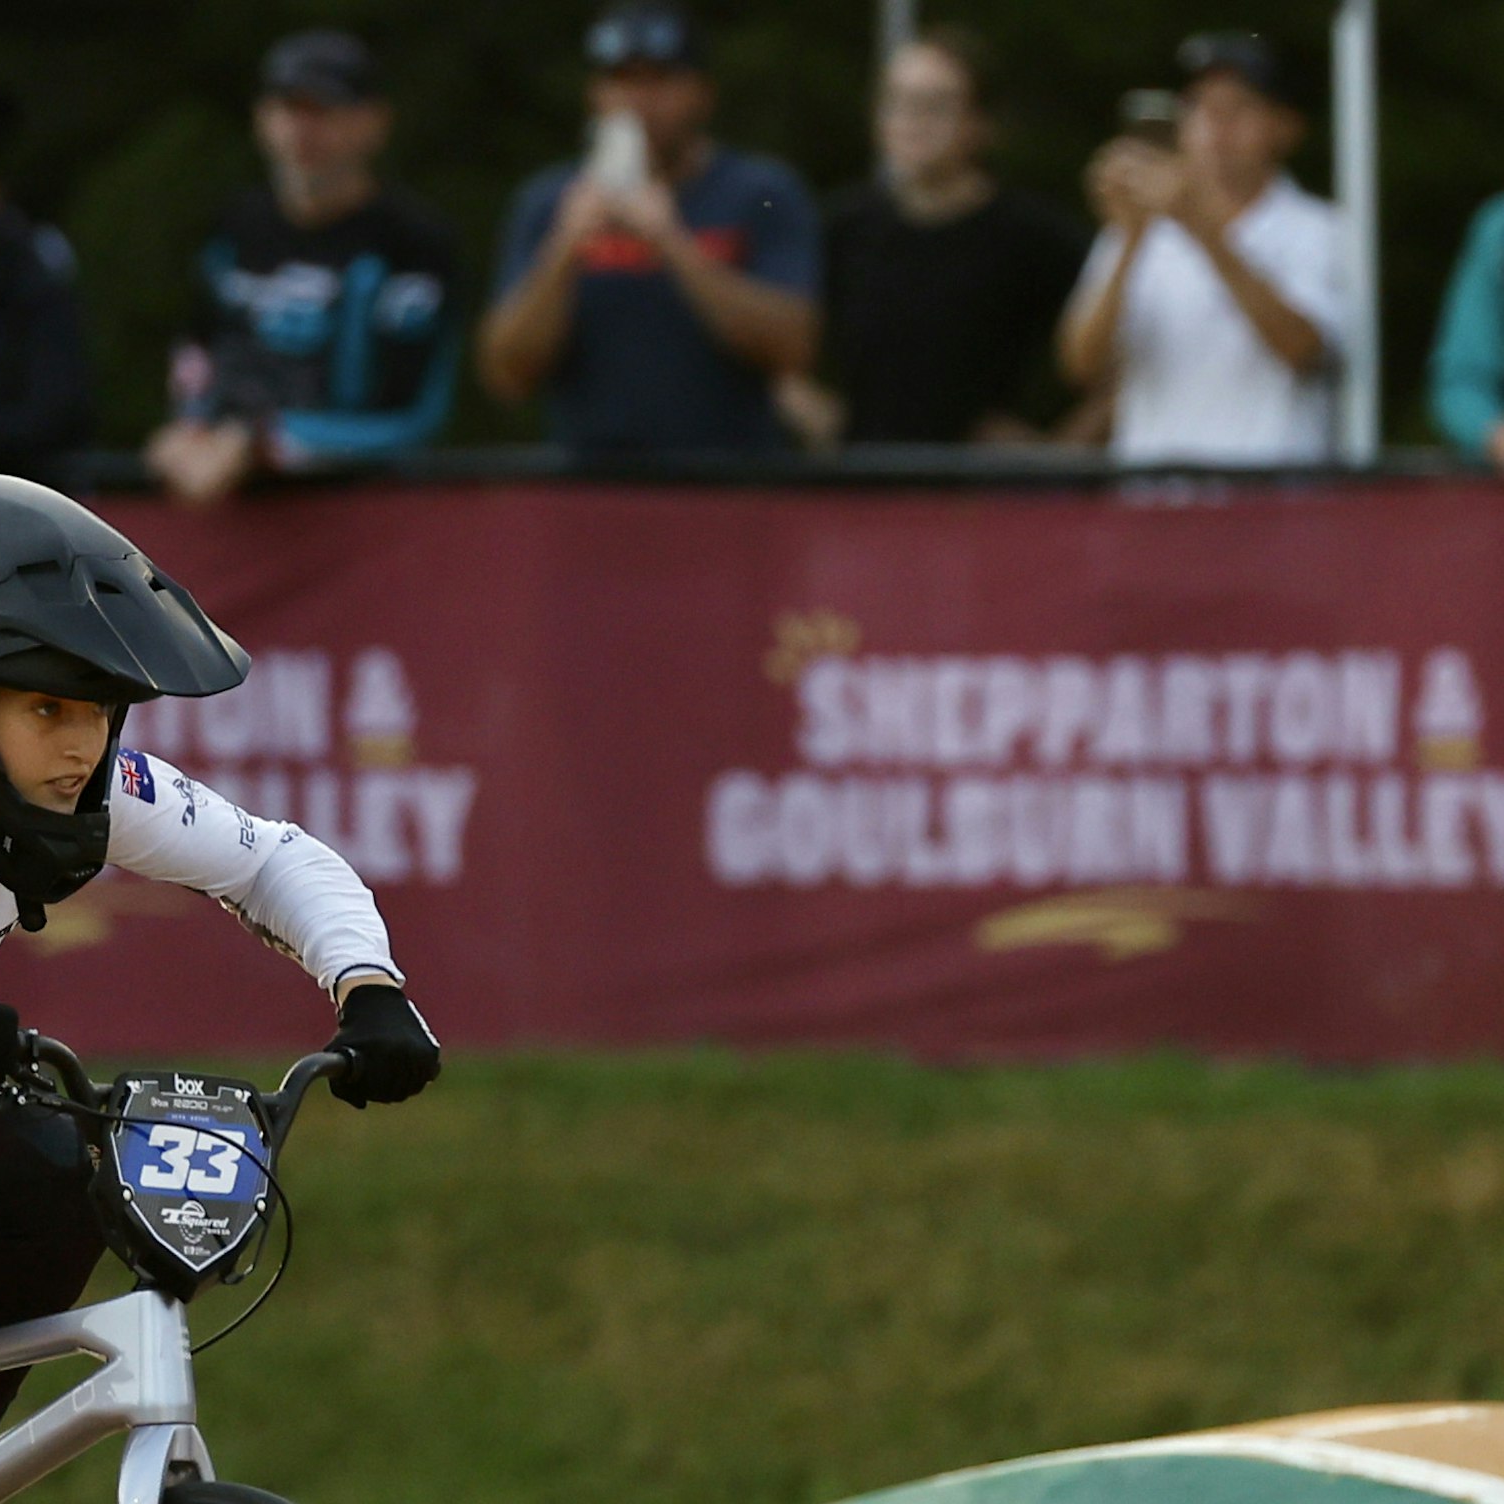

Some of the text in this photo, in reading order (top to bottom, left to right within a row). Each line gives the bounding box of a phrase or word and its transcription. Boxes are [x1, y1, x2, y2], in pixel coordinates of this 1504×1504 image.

[797, 652, 1402, 766] SHEPPARTON
[706, 768, 1191, 886] GOULBURN
[174, 1072, 205, 1096] box
[140, 1124, 246, 1195] 33
